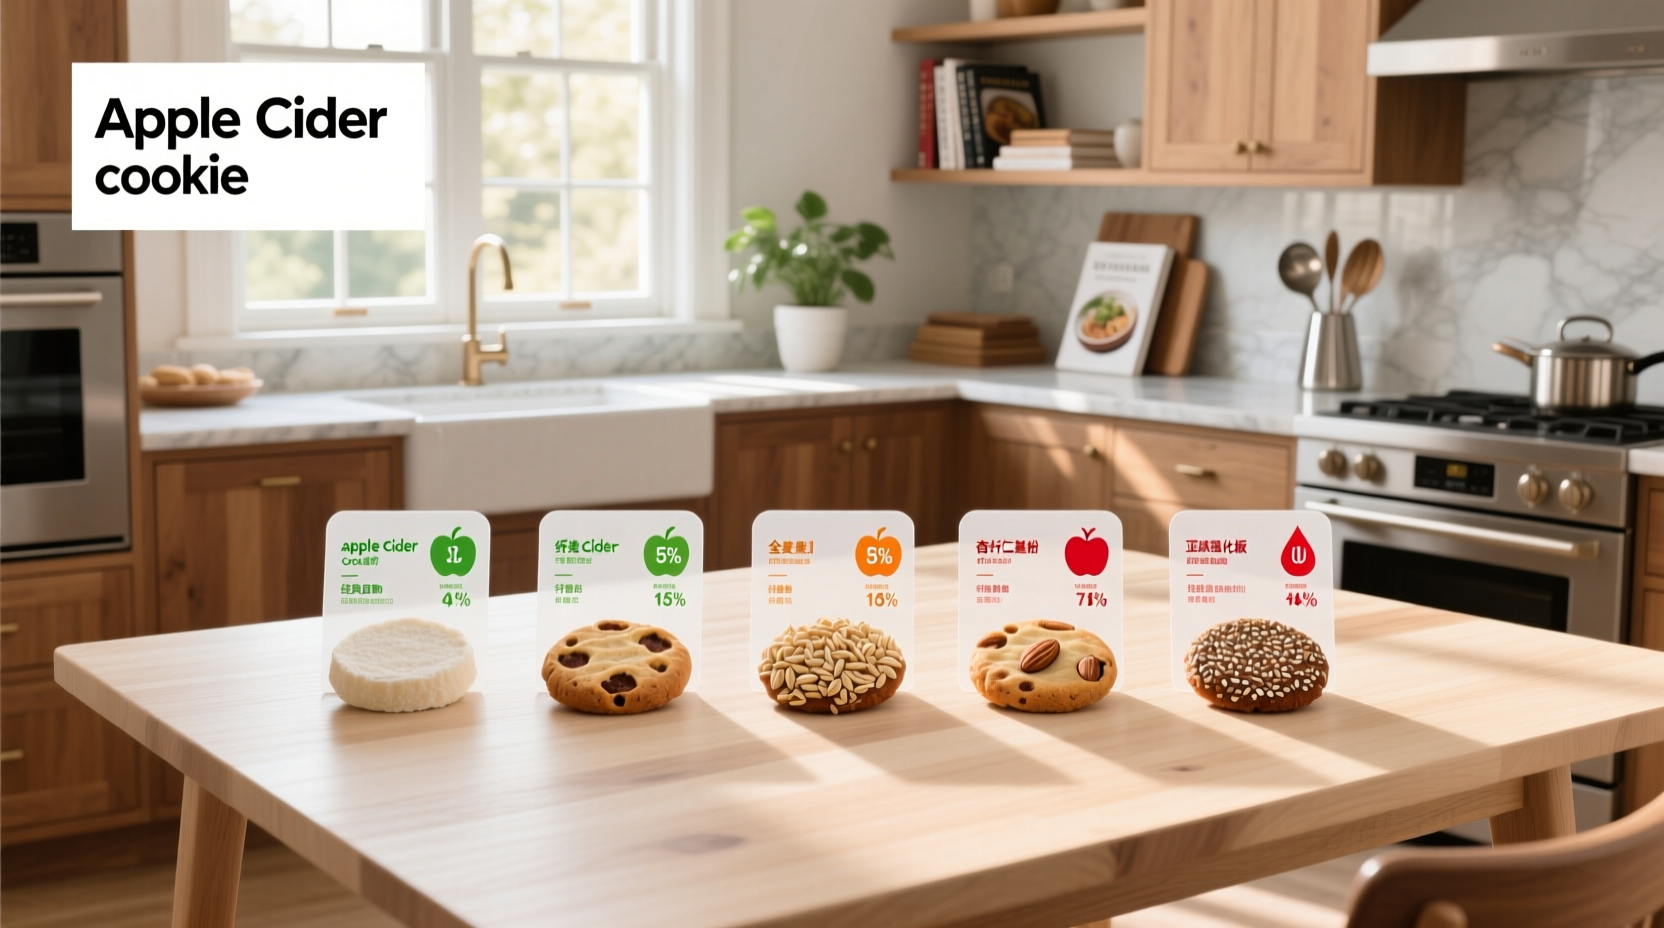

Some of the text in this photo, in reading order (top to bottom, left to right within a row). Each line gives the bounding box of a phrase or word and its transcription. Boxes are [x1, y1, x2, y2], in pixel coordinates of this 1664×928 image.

[341, 539, 418, 555] Apple Cider
[656, 546, 682, 564] 5%
[654, 592, 686, 607] 15%
